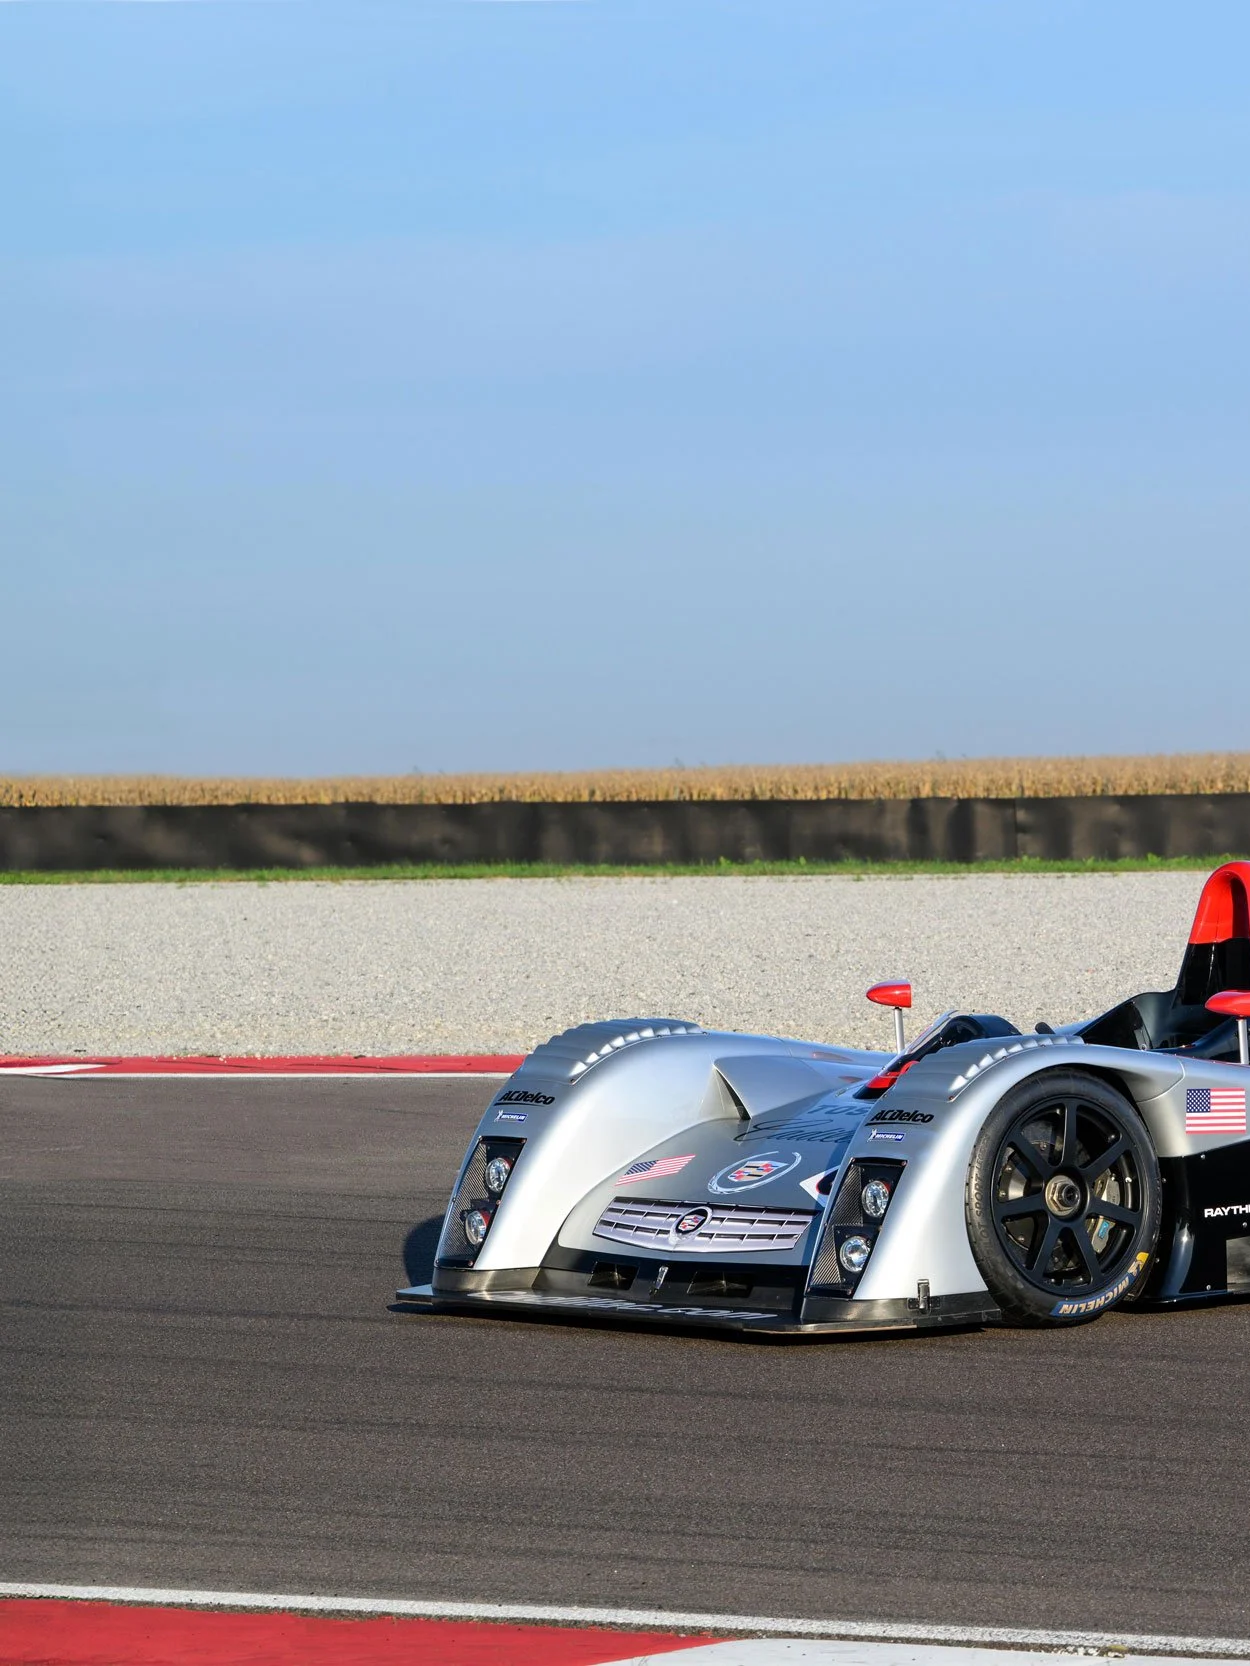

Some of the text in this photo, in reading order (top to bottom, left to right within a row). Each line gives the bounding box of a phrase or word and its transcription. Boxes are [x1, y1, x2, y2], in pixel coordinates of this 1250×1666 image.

[497, 1090, 556, 1105] ACDelco
[870, 1110, 935, 1123] ACDelco
[1059, 1276, 1130, 1314] MICHELIN
